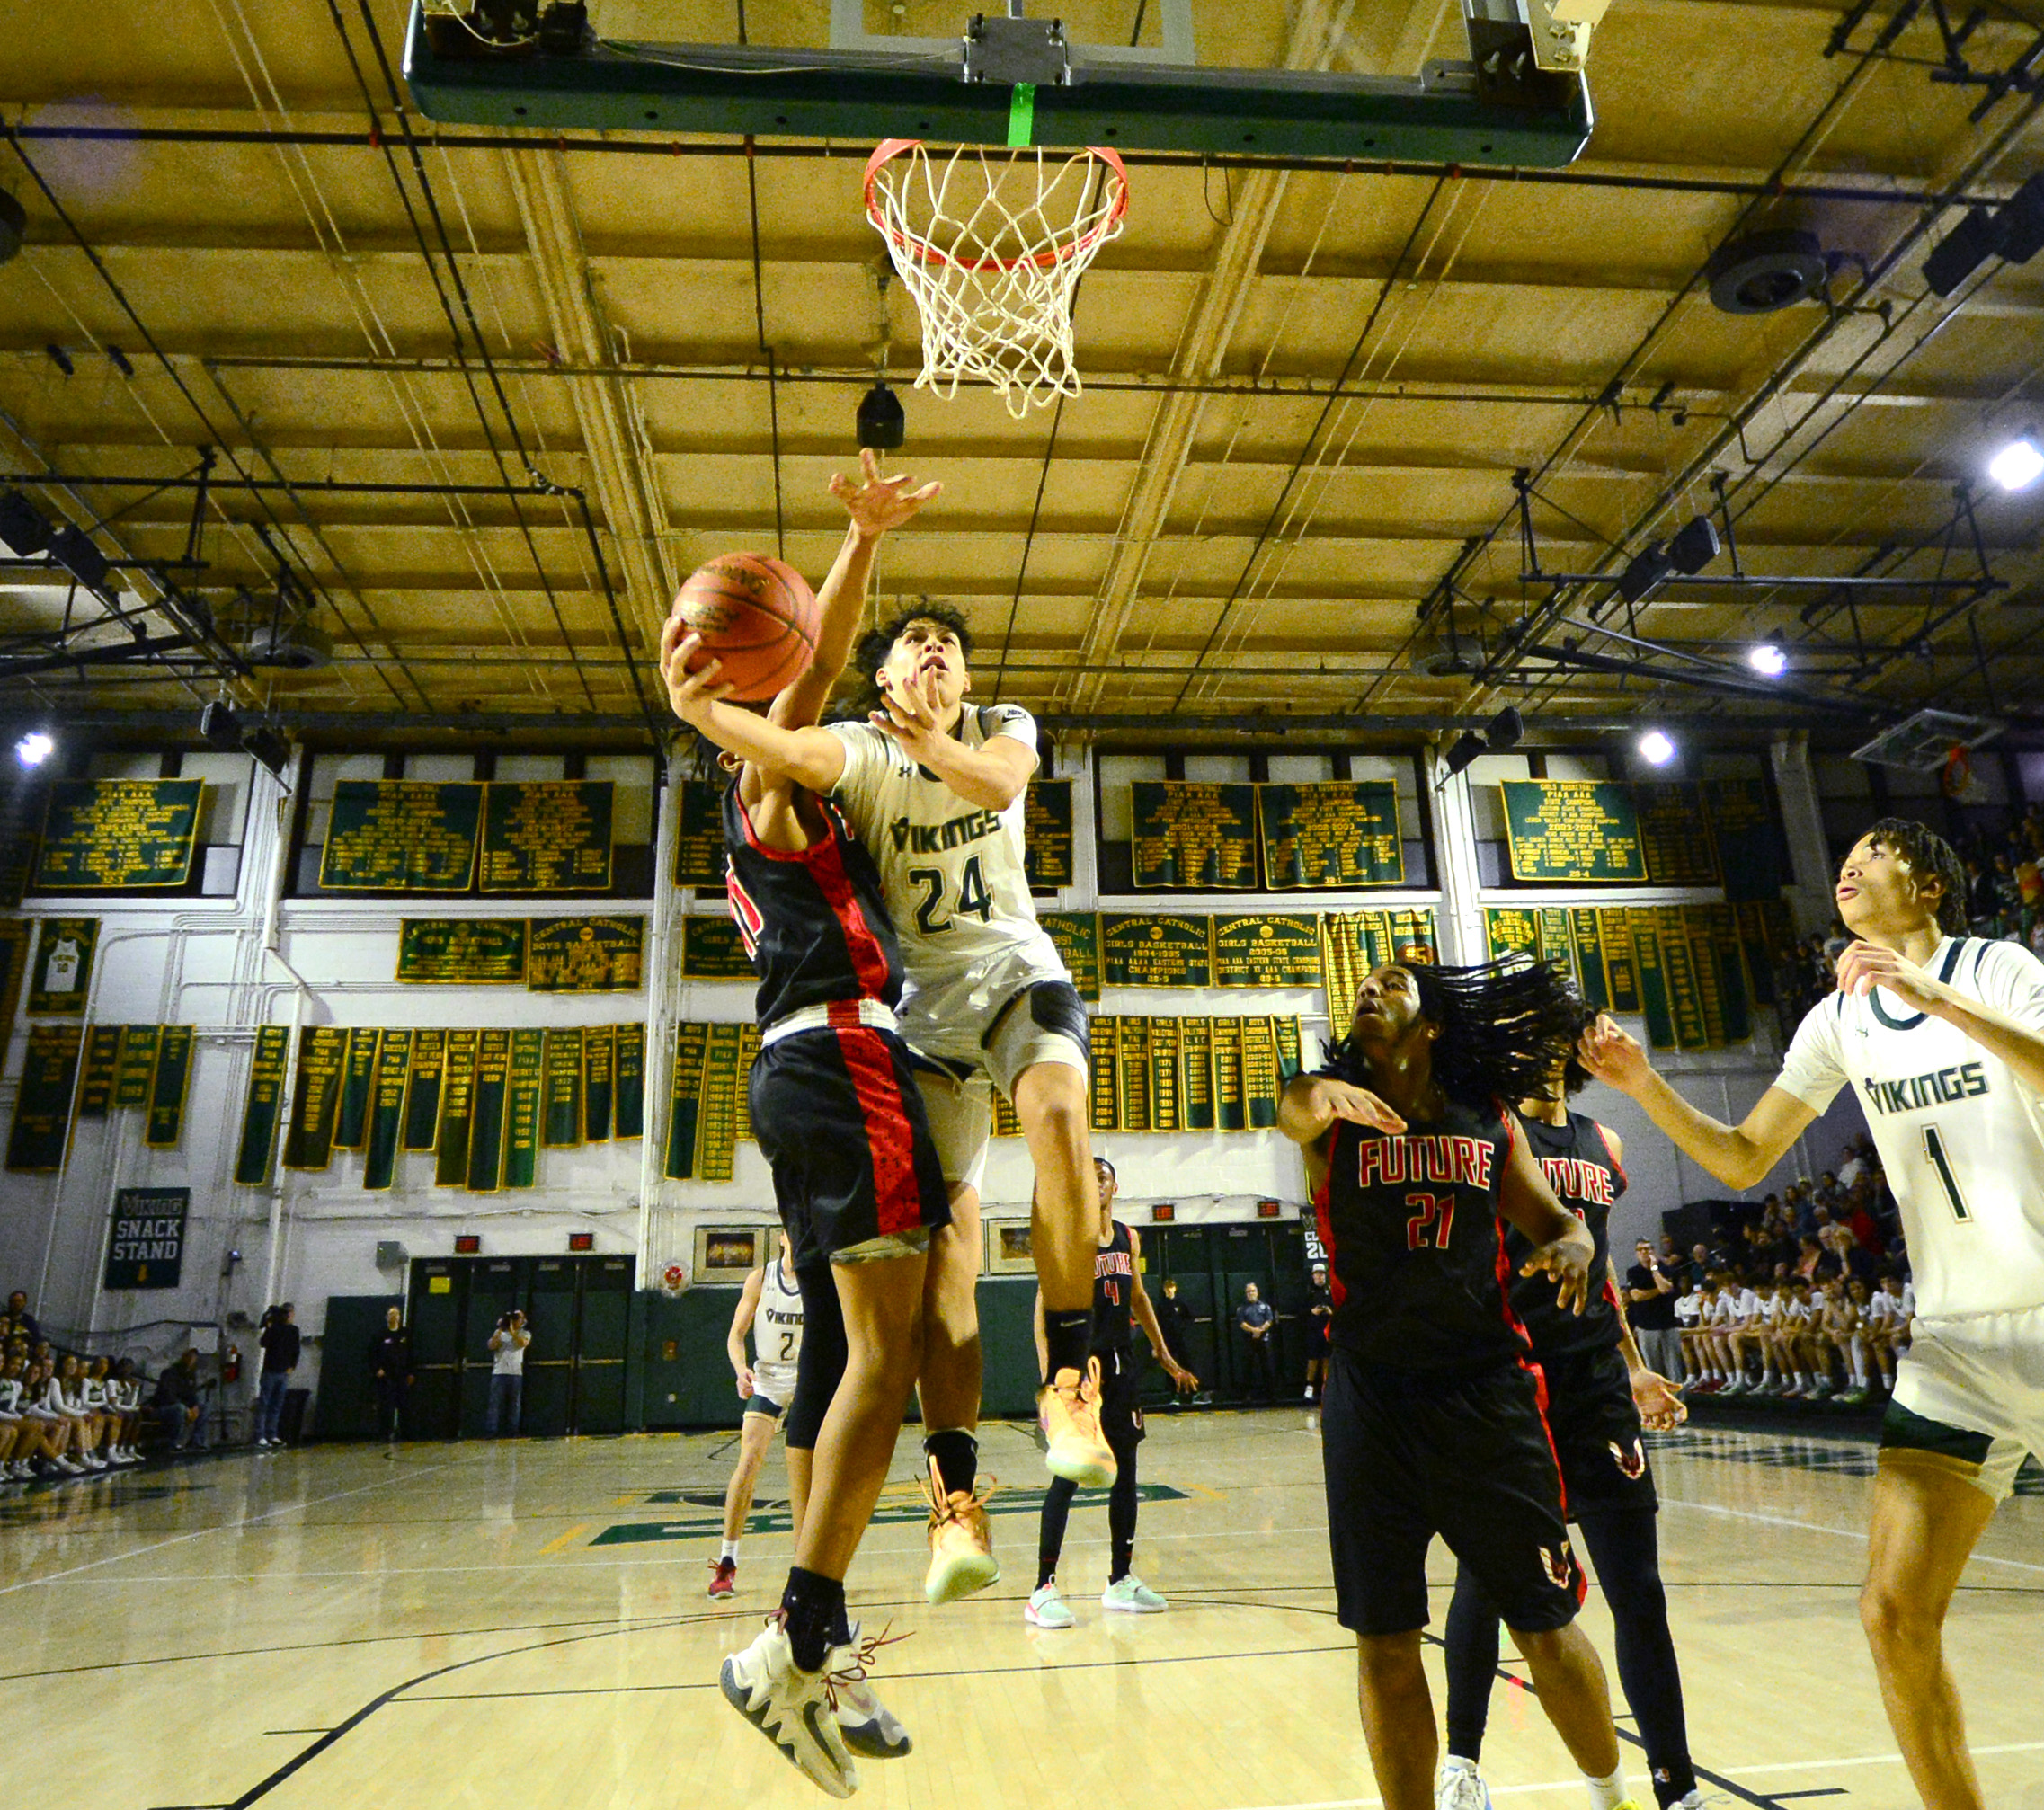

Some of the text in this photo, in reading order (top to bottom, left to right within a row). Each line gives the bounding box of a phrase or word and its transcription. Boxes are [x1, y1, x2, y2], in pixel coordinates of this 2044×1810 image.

[889, 809, 1002, 854] VIKINGS
[1548, 823, 1599, 831] 2003-2004
[906, 850, 995, 938] 24
[533, 918, 639, 941] CENTRAL CATHOLIC
[1106, 917, 1206, 938] CENTRAL CATHOLIC
[1216, 917, 1315, 936] CENTRAL CATHOLIC
[1105, 940, 1208, 950] GIRLS BASKETBALL
[1217, 938, 1318, 947] GIRLS BASKETBALL
[1128, 965, 1186, 974] CHAMPIONS
[1186, 1018, 1205, 1026] GIRLS
[1217, 1018, 1236, 1026] GIRLS
[1863, 1061, 1990, 1115] VIKINGS
[1359, 1135, 1495, 1190] FUTURE
[1920, 1122, 1974, 1224] 1
[1533, 1157, 1614, 1206] UTURE
[116, 1220, 182, 1238] SNACK
[1406, 1193, 1454, 1250] 21
[113, 1241, 179, 1260] STAND
[1094, 1252, 1133, 1279] UTURE
[1104, 1280, 1120, 1306] 4
[780, 1332, 794, 1361] 2
